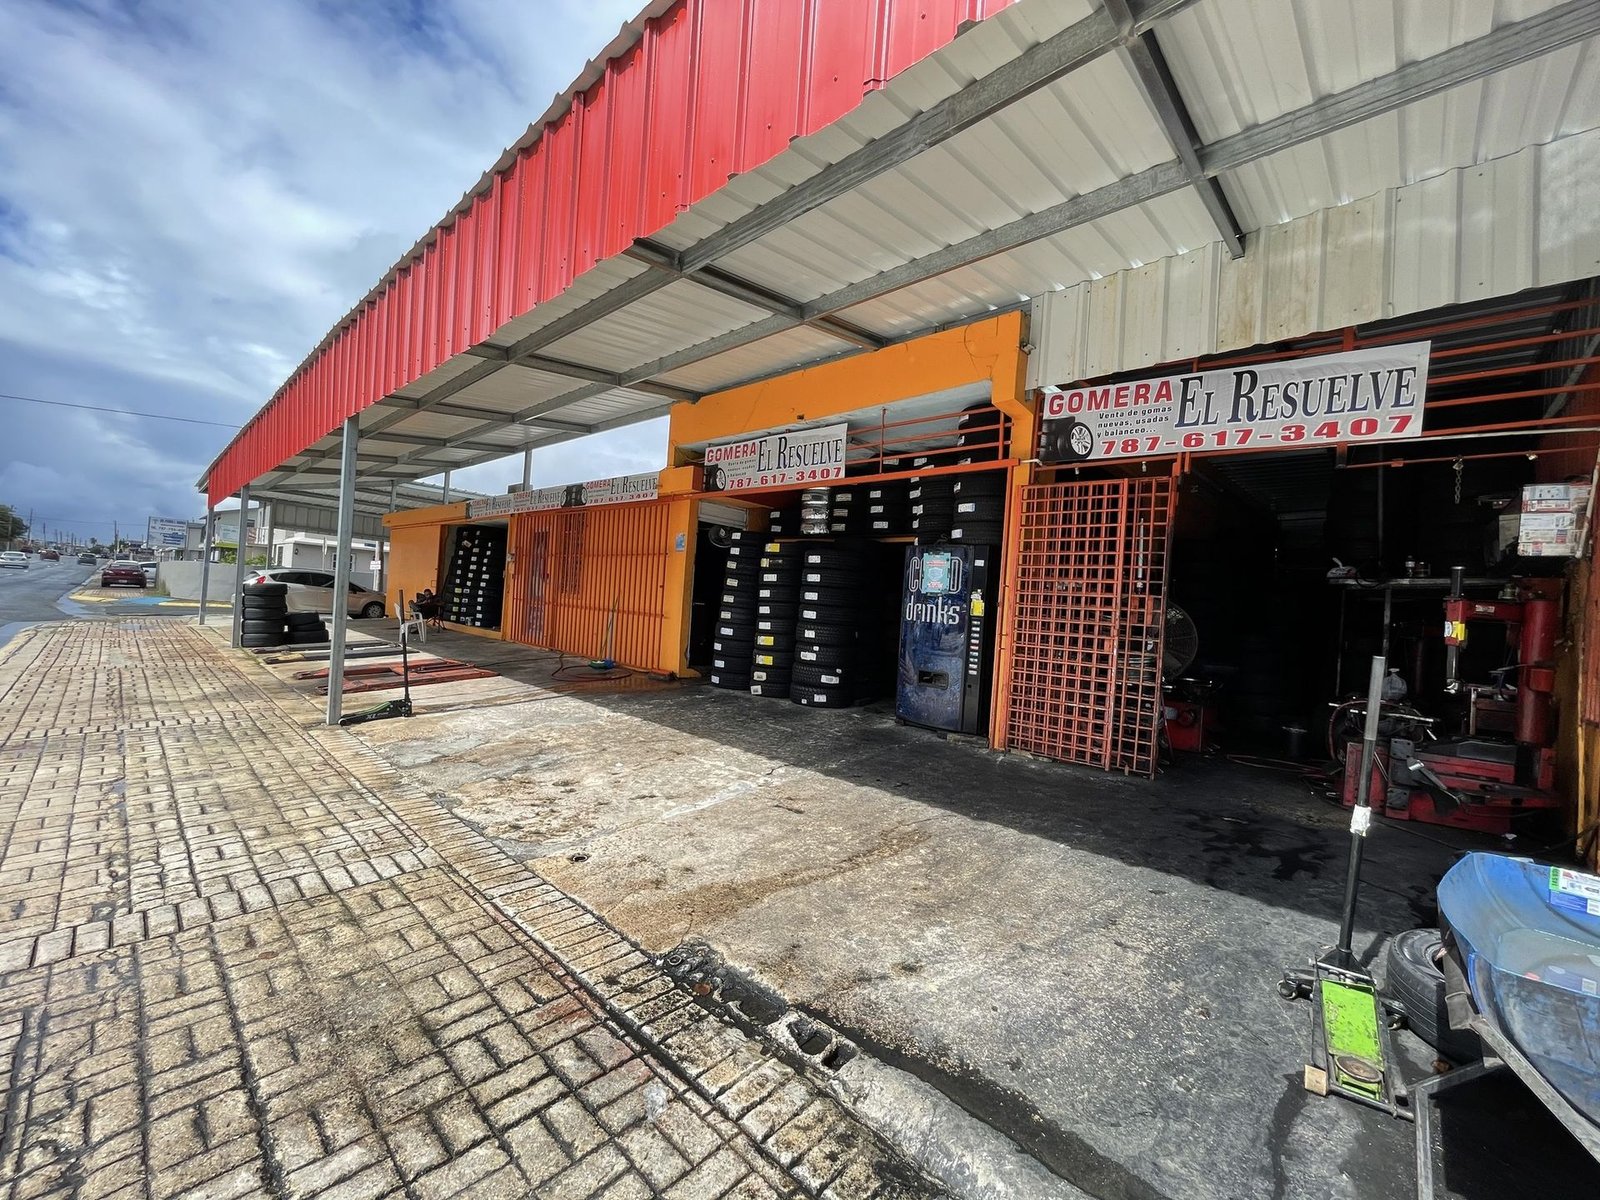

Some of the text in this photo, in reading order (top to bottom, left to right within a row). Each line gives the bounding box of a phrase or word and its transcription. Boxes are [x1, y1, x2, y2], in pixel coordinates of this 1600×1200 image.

[1049, 366, 1417, 428] GOMERA EL RESUELVE
[1097, 415, 1169, 429] nuevas, usadas
[1099, 405, 1173, 420] Venta de gomas
[1101, 414, 1413, 456] 787-617-3407
[706, 441, 756, 463] GOMERA
[777, 436, 843, 471] RESUELVE
[585, 479, 611, 490] GOMERA
[728, 466, 842, 489] 787-617-3407
[908, 556, 962, 594] CD
[906, 595, 960, 625] drinks
